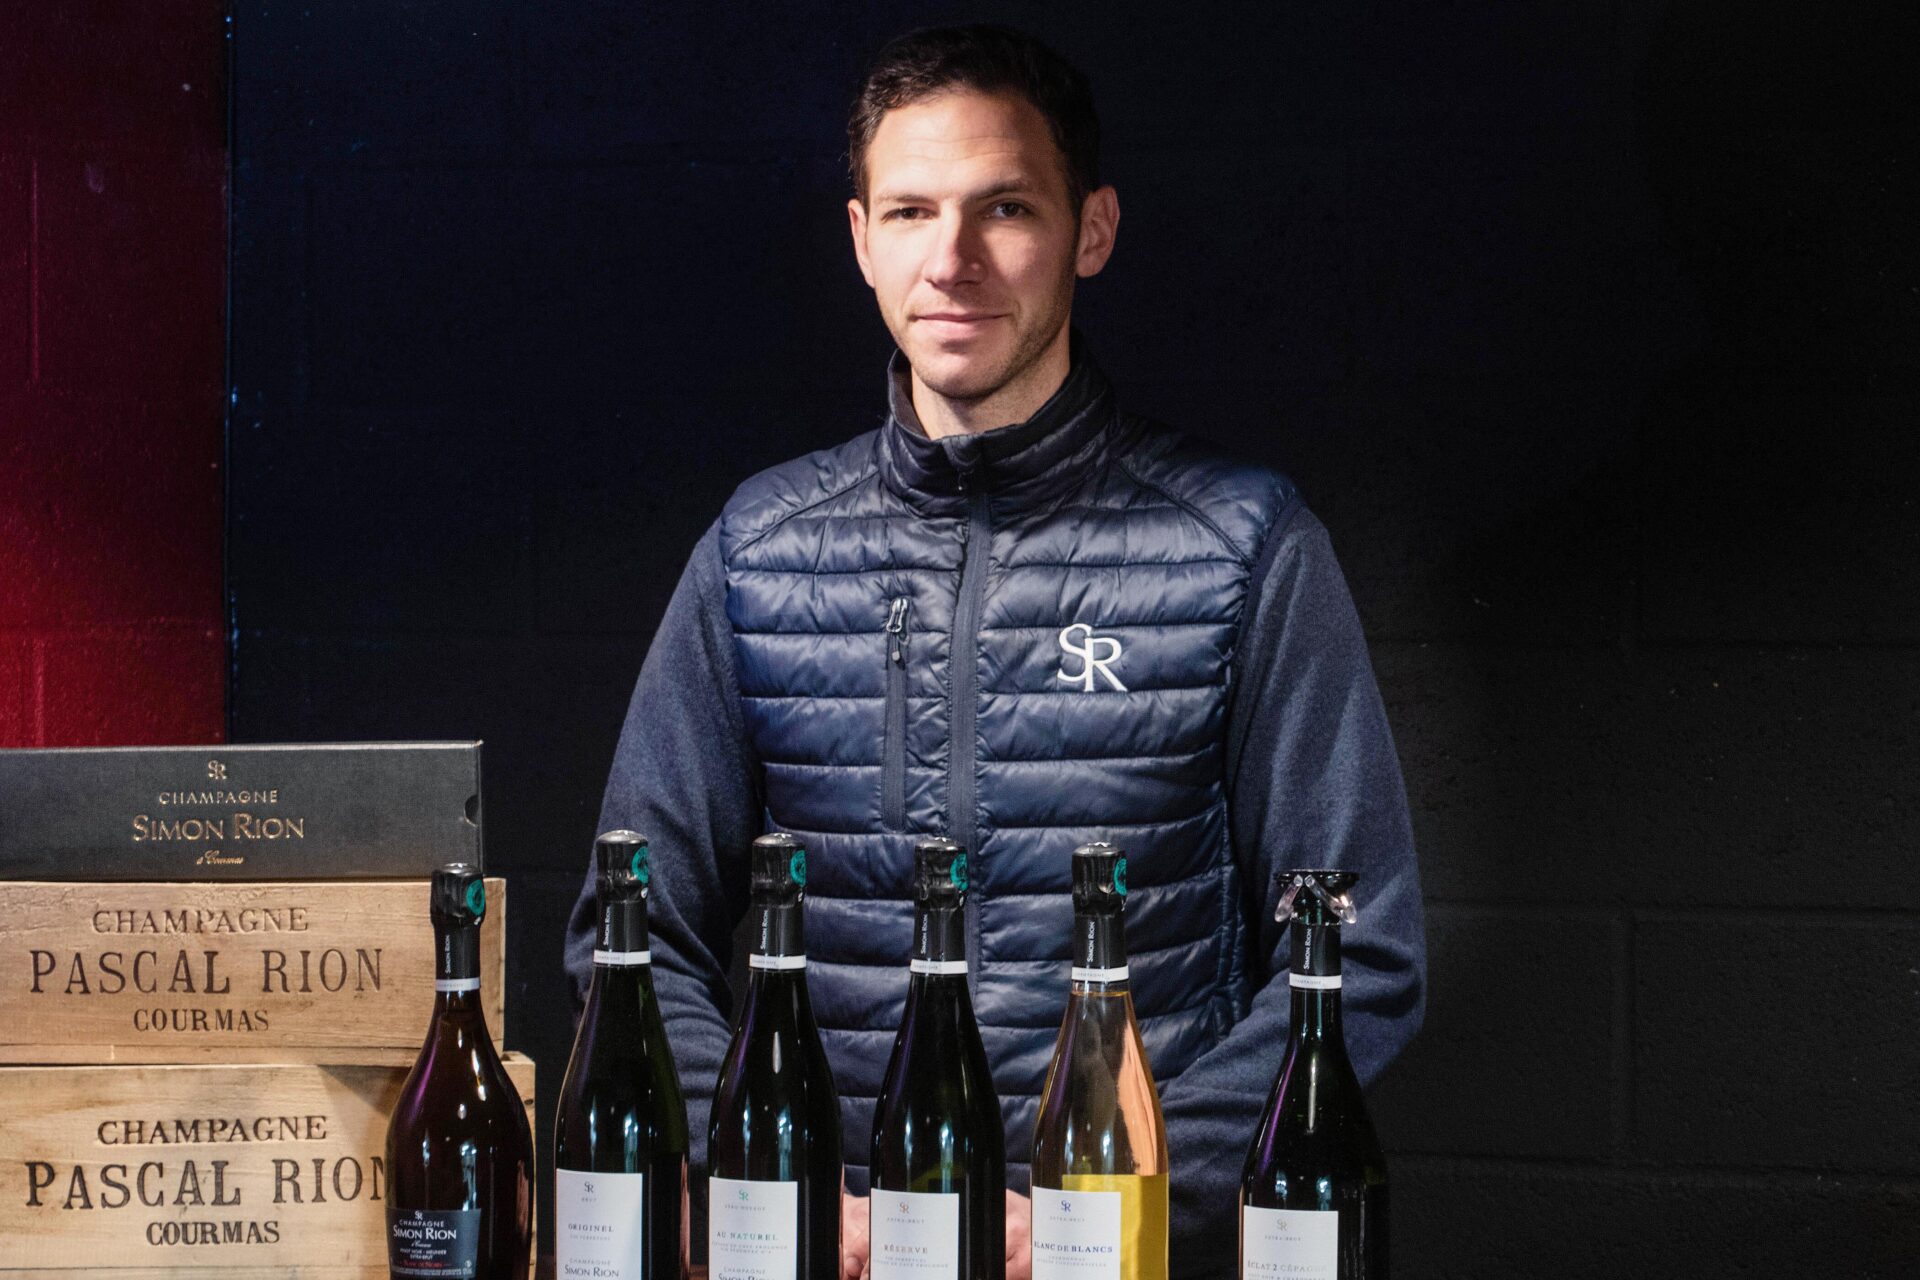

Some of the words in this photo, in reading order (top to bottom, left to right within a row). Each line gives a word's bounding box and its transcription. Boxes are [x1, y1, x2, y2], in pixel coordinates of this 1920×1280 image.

[1057, 623, 1128, 692] SR
[208, 760, 228, 780] SR
[158, 789, 279, 805] CHAMPAGNE
[131, 814, 225, 842] SIMON
[233, 812, 305, 841] RION
[92, 906, 310, 935] CHAMPAGNE
[29, 949, 231, 995] PASCAL
[261, 948, 383, 994] RION
[133, 1008, 270, 1032] COURMAS
[97, 1115, 328, 1145] CHAMPAGNE
[24, 1160, 242, 1210] PASCAL
[146, 1221, 281, 1246] COURMAS
[393, 1224, 423, 1239] SIMON
[425, 1227, 457, 1240] RION
[399, 1219, 445, 1229] CHAMPAGNE
[568, 1223, 615, 1233] ORIGINEL
[1071, 1245, 1113, 1253] BLANCS
[564, 1264, 590, 1276] SIMON
[593, 1266, 620, 1278] RION
